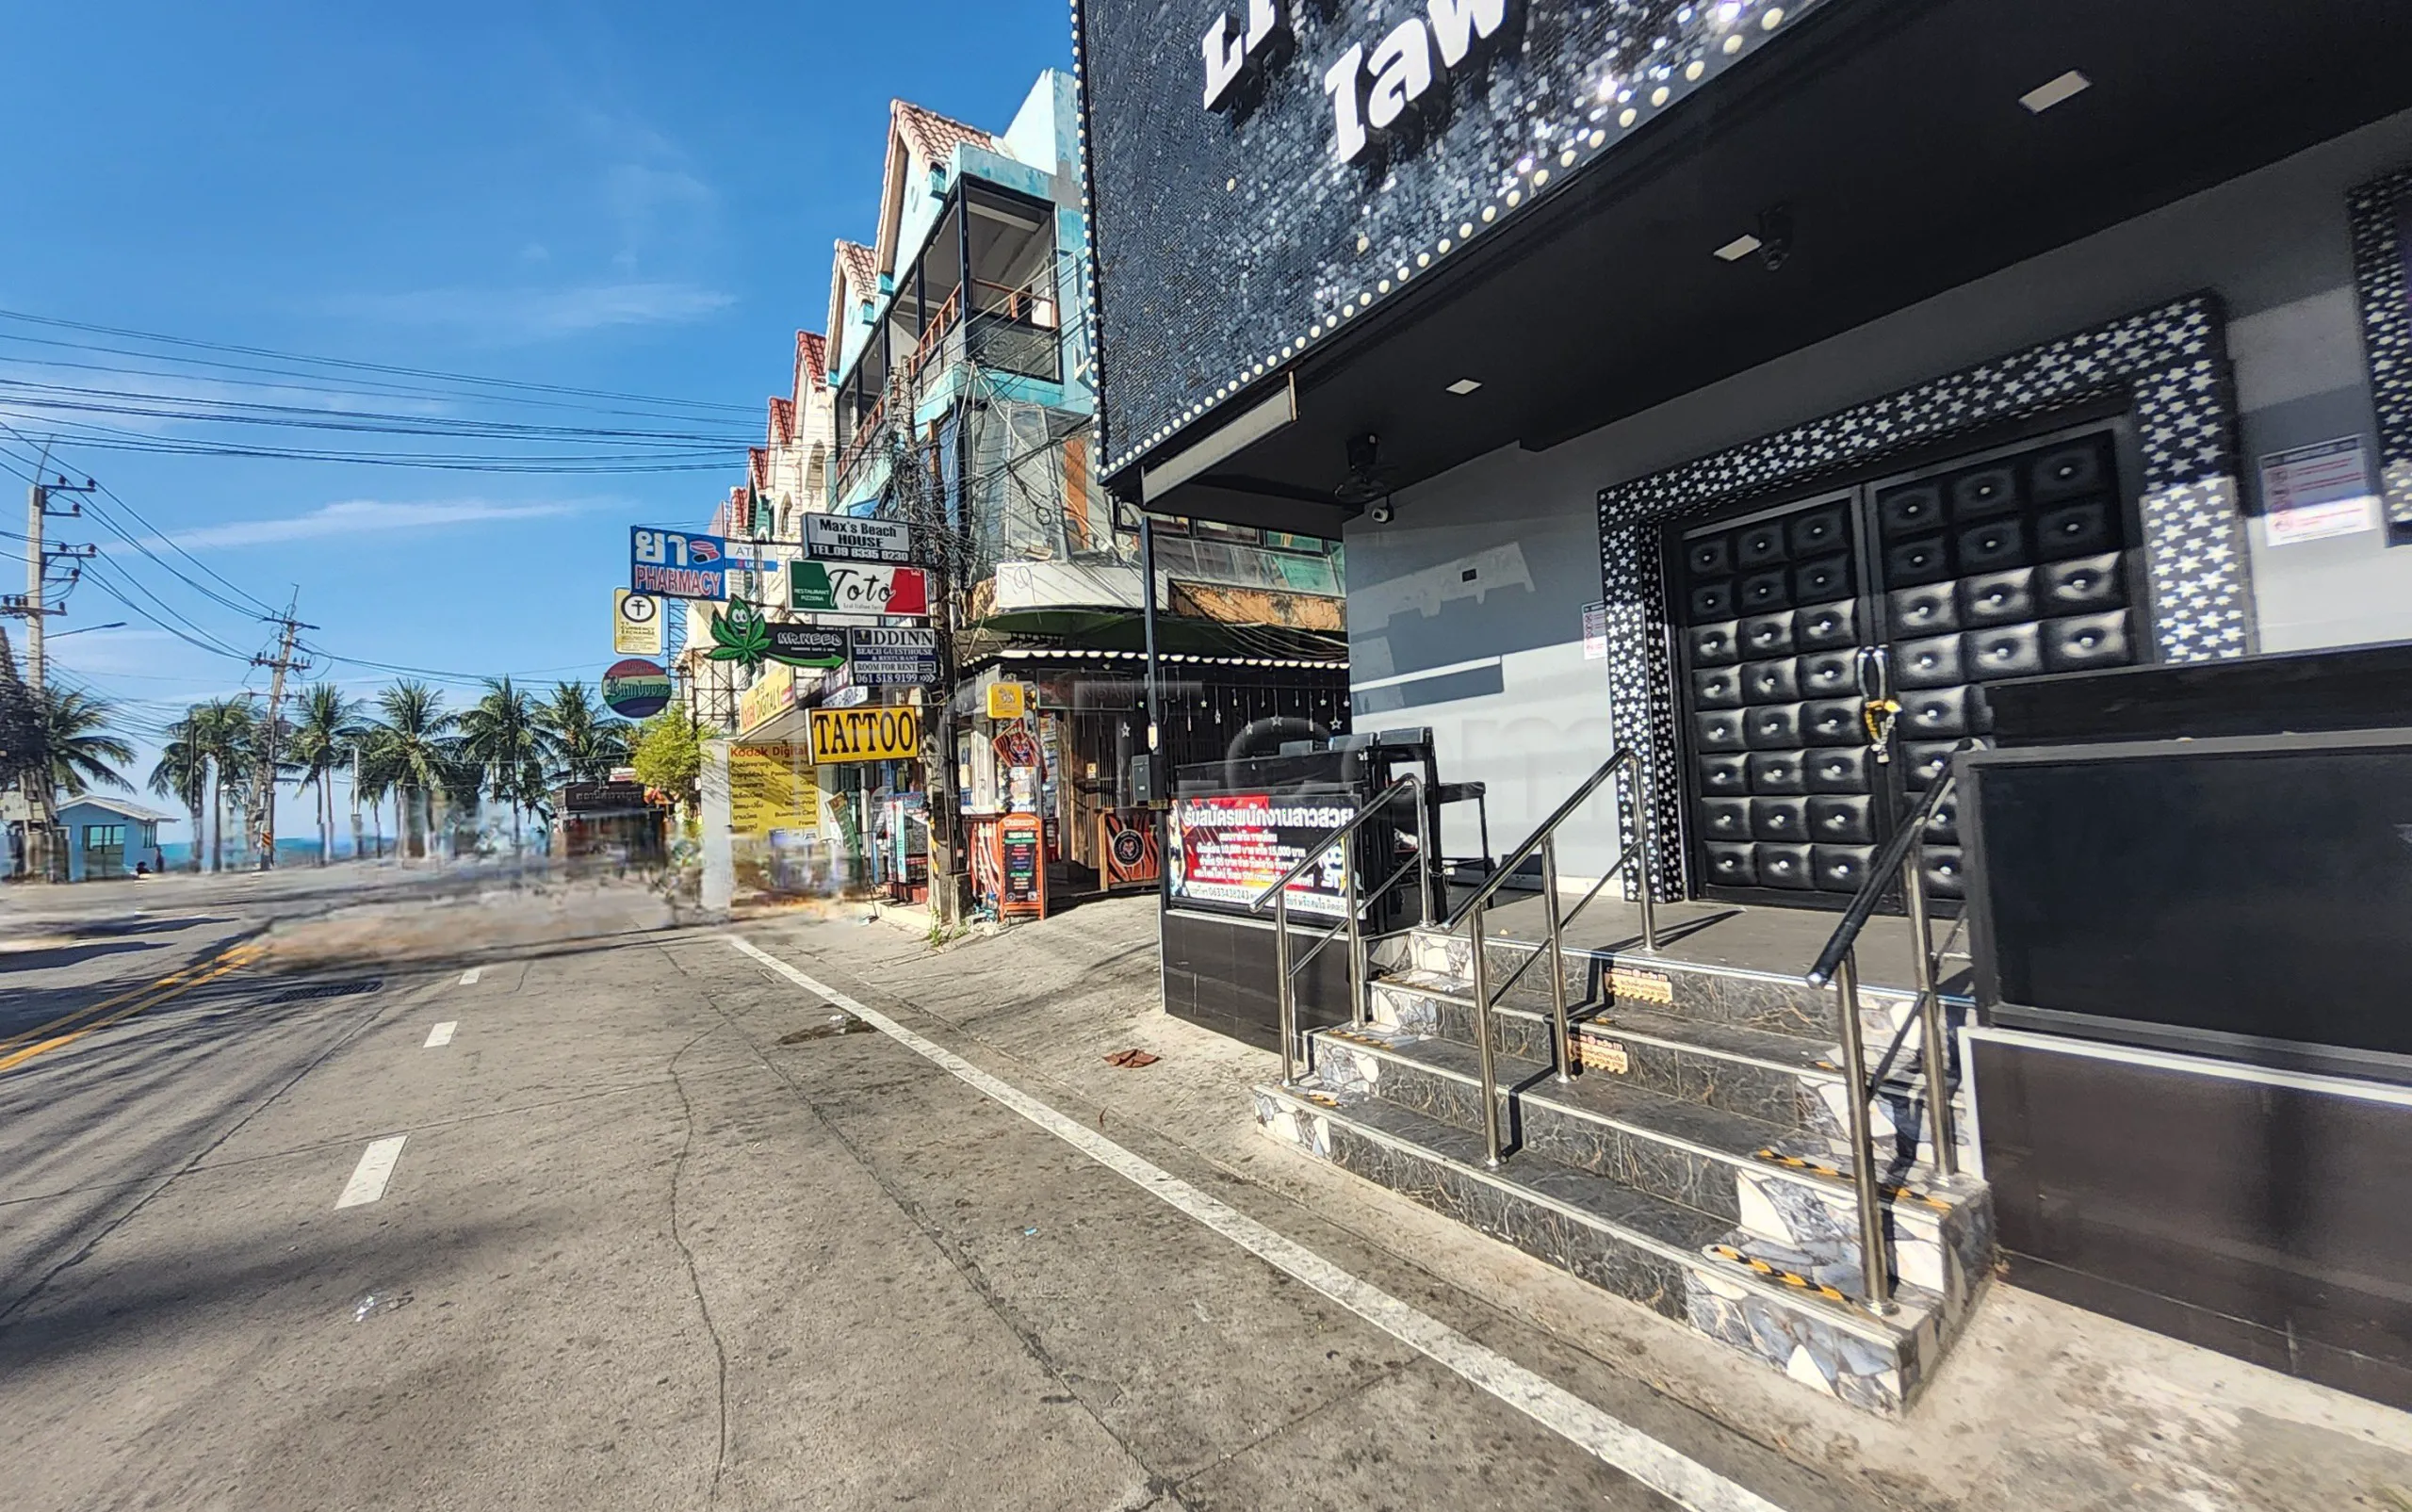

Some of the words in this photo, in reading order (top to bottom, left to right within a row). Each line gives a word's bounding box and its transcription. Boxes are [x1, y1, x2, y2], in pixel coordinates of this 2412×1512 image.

[819, 519, 857, 533] Max's
[861, 523, 897, 537] Beach
[635, 530, 688, 566] ยา
[838, 534, 884, 547] HOUSE
[635, 564, 723, 595] PHARMACY
[873, 630, 933, 645] DDINN
[856, 647, 882, 656] BEACH
[856, 662, 880, 671] ROOM
[881, 662, 896, 671] FOR
[897, 663, 917, 672] RENT
[856, 674, 873, 684] 061
[875, 674, 893, 684] 518
[894, 674, 918, 684] 9199
[814, 712, 914, 755] TATTOO
[730, 746, 769, 757] Kodak
[772, 745, 808, 758] Digital
[1183, 804, 1355, 828] รับสมัครพนักงานสาวสวย
